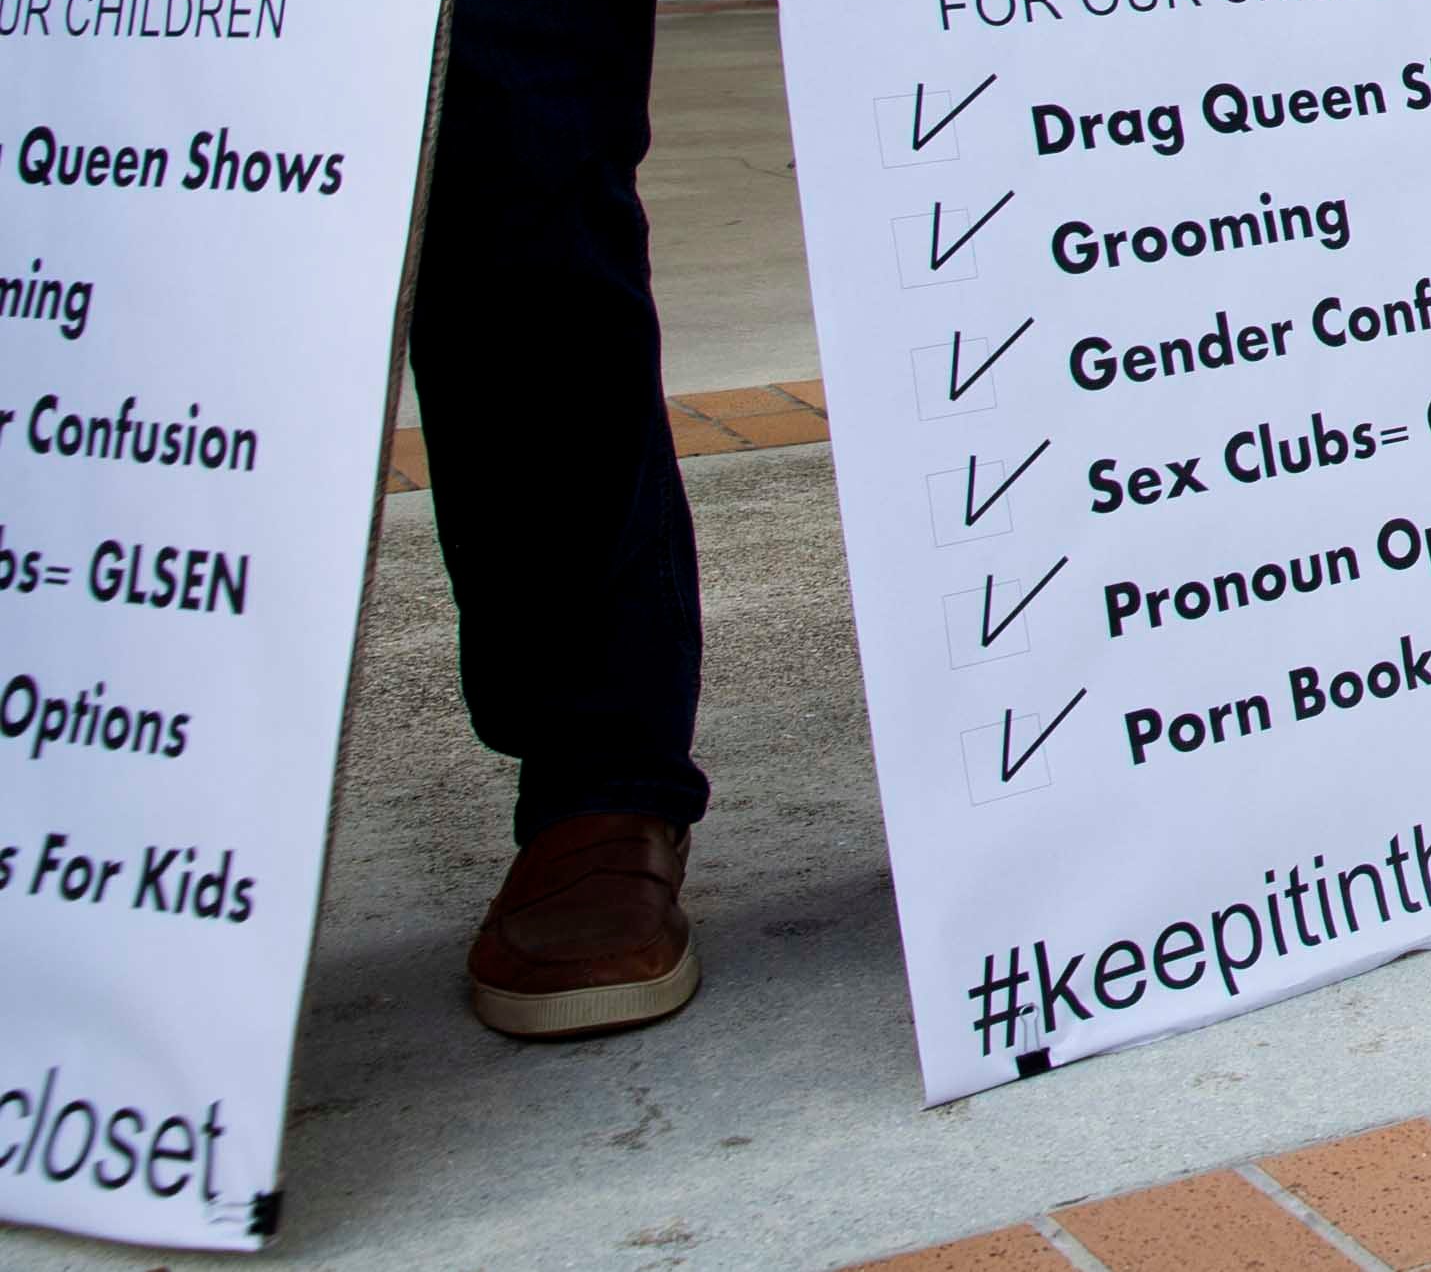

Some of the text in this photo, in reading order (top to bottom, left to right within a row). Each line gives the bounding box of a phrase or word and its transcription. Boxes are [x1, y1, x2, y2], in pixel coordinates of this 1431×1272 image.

[1032, 105, 1184, 155] Drag
[1203, 83, 1386, 133] Queen
[19, 126, 168, 187] Queen
[182, 128, 344, 194] Shows
[1052, 193, 1349, 274] Grooming
[1070, 312, 1292, 390] Gender
[28, 395, 256, 470] Confusion
[1089, 458, 1208, 513] Sex
[90, 540, 248, 614] GLSEN
[1105, 547, 1360, 637] Pronoun
[0, 675, 189, 759] Options
[1125, 696, 1271, 765] Porn
[30, 834, 121, 902] For
[134, 847, 253, 922] Kids
